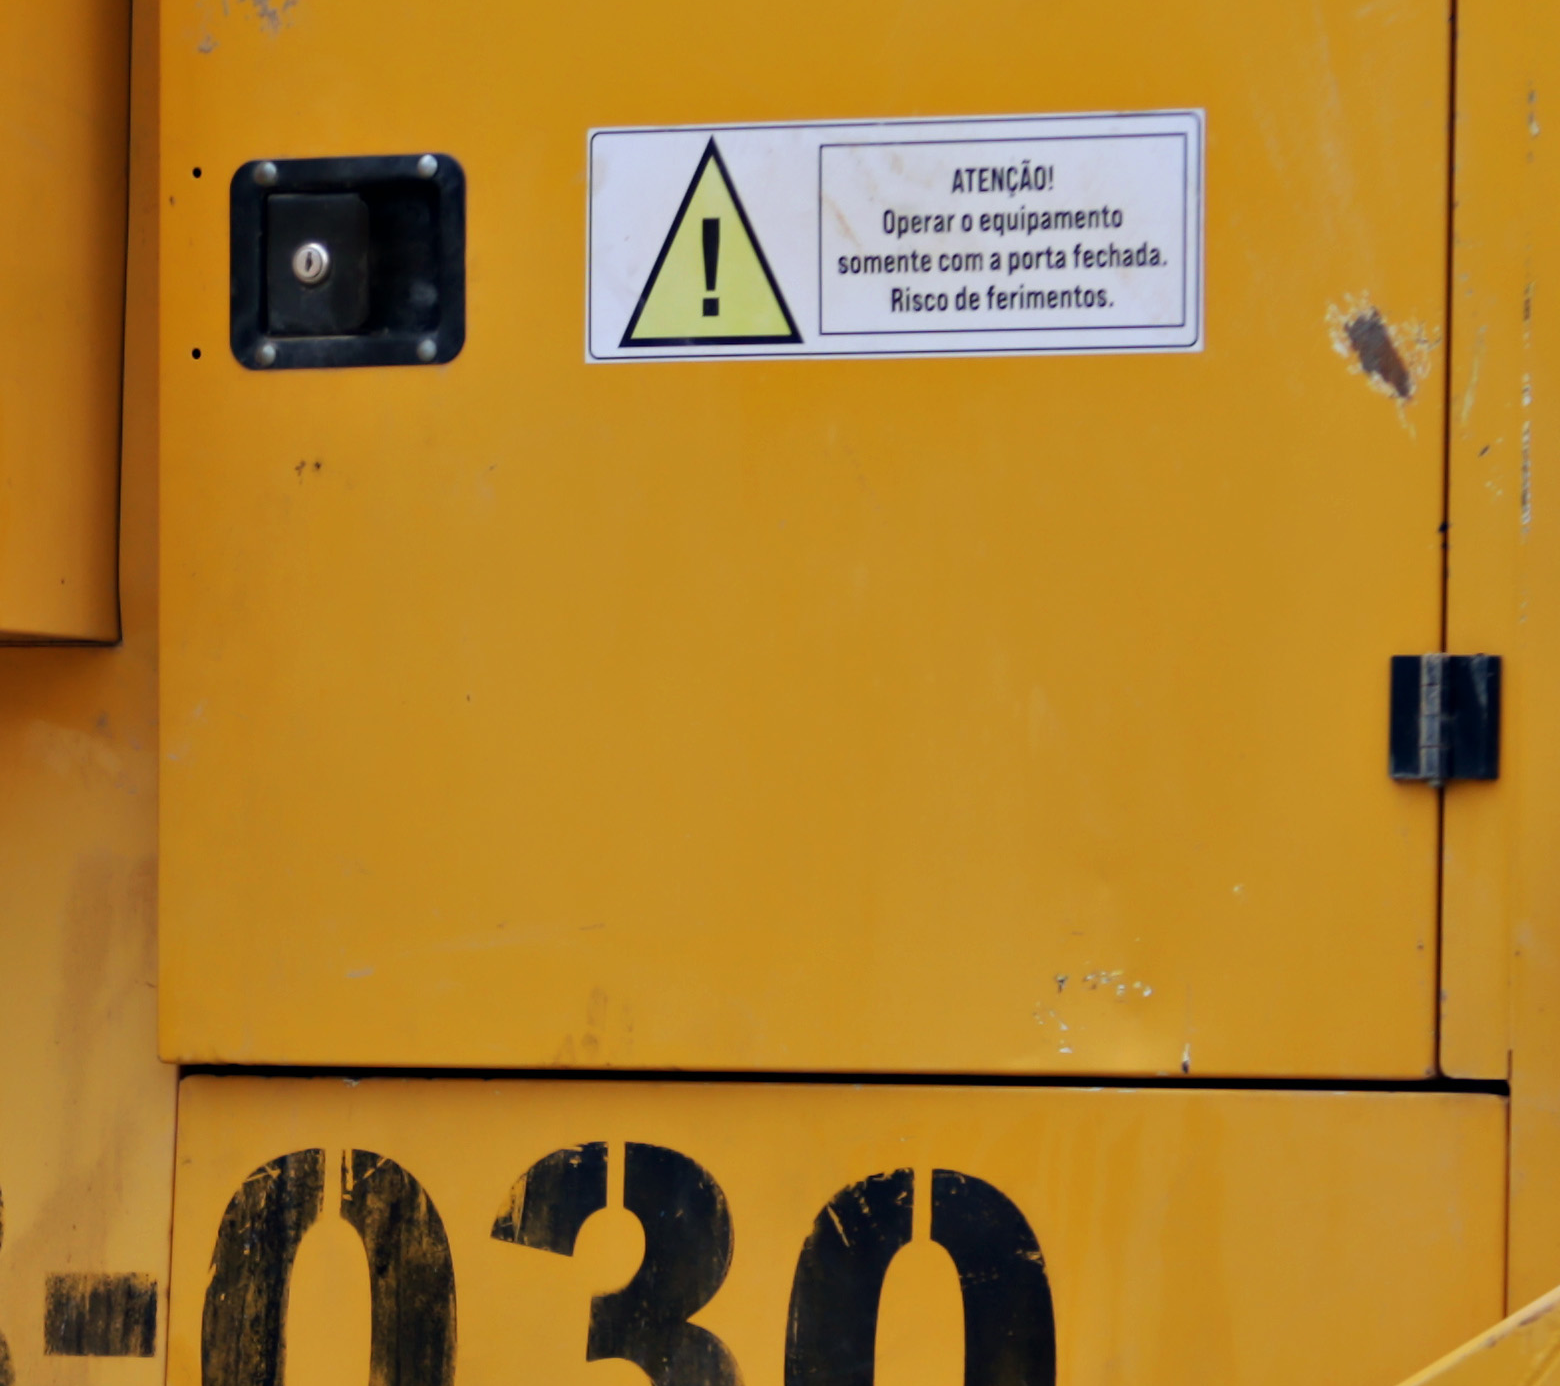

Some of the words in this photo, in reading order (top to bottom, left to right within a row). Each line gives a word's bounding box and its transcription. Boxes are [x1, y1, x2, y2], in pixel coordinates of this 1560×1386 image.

[951, 160, 1055, 198] ATENÇÃO!
[882, 209, 958, 239] Operar
[961, 215, 973, 233] o
[979, 205, 1123, 235] equipamento
[837, 249, 932, 276] somente
[937, 251, 983, 274] com
[989, 251, 1002, 272] a
[1007, 247, 1068, 276] porta
[1072, 243, 1169, 270] fechada.
[890, 286, 949, 314] Risco
[954, 285, 981, 311] de
[986, 284, 1116, 310] ferimentos.
